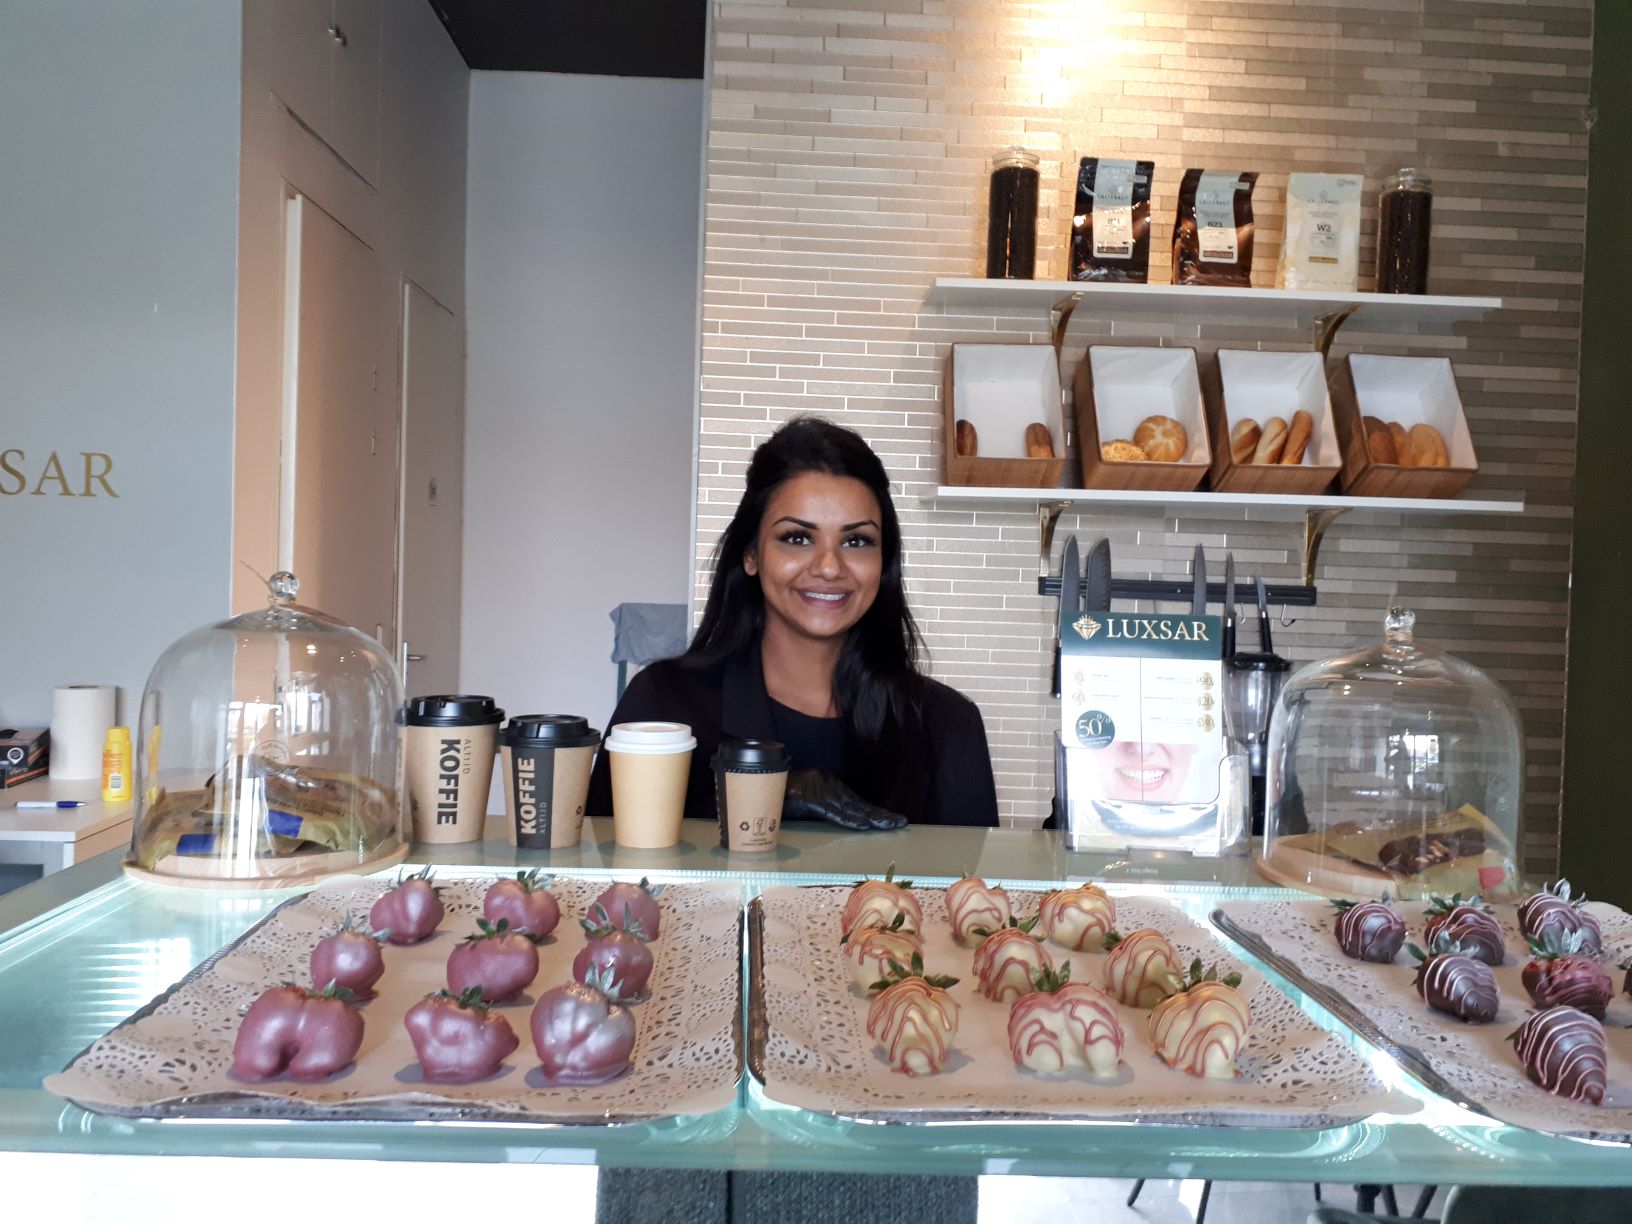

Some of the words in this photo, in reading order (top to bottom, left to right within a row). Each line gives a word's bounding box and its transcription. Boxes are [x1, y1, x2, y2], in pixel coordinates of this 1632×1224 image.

[1316, 223, 1332, 233] W2
[0, 448, 120, 498] SAR
[1106, 618, 1210, 642] LUXSAR
[437, 738, 461, 825] KOFFIE
[517, 757, 537, 834] KOFFIE
